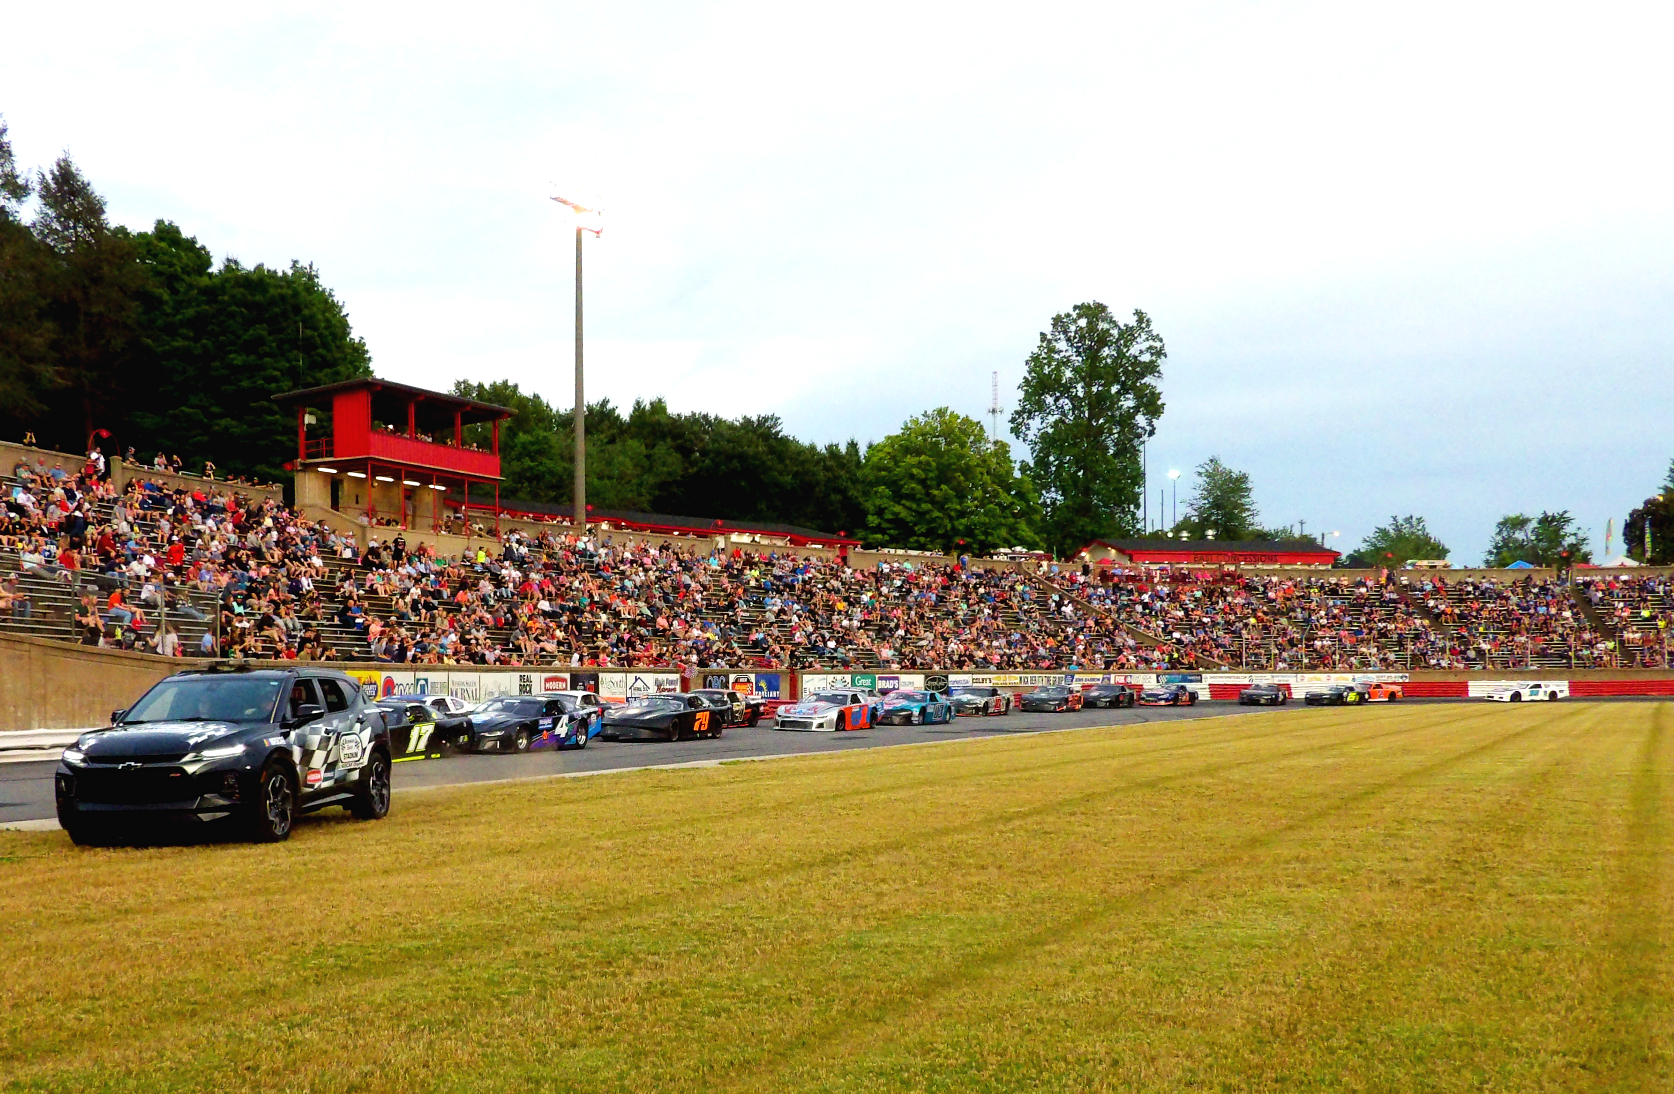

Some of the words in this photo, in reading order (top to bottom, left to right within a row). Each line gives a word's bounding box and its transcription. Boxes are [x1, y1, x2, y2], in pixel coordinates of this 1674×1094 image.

[1193, 555, 1213, 563] EAST
[1217, 555, 1279, 563] CONCESSIONS
[519, 674, 533, 683] REAL
[855, 675, 872, 686] Great
[877, 679, 899, 689] BRAD'S
[519, 684, 533, 696] ROCK
[545, 681, 566, 690] MODERN
[554, 714, 570, 738] 4
[693, 710, 710, 731] 79
[406, 723, 435, 753] 17
